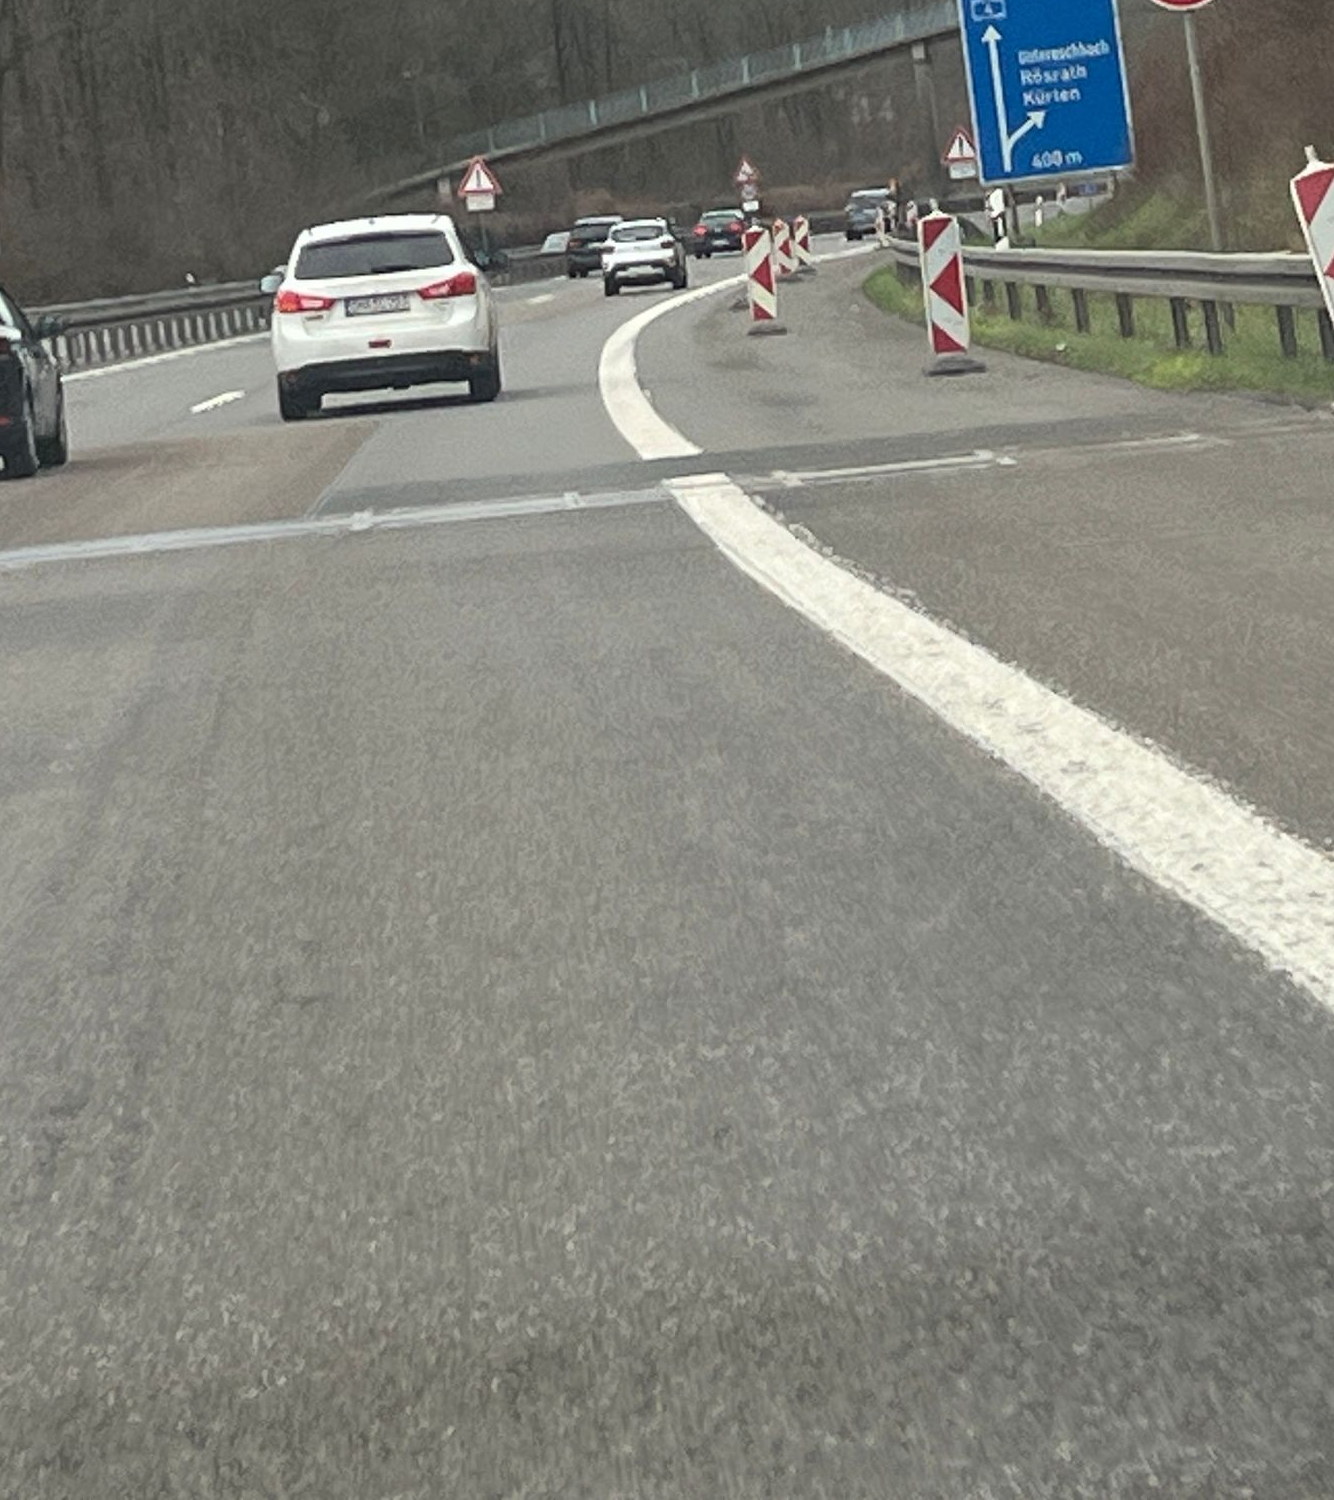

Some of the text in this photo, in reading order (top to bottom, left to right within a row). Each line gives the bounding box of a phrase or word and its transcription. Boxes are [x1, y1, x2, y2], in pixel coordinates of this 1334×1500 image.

[1020, 65, 1087, 85] Rösrath
[1023, 88, 1081, 105] Kürten
[1032, 151, 1083, 168] 400 m
